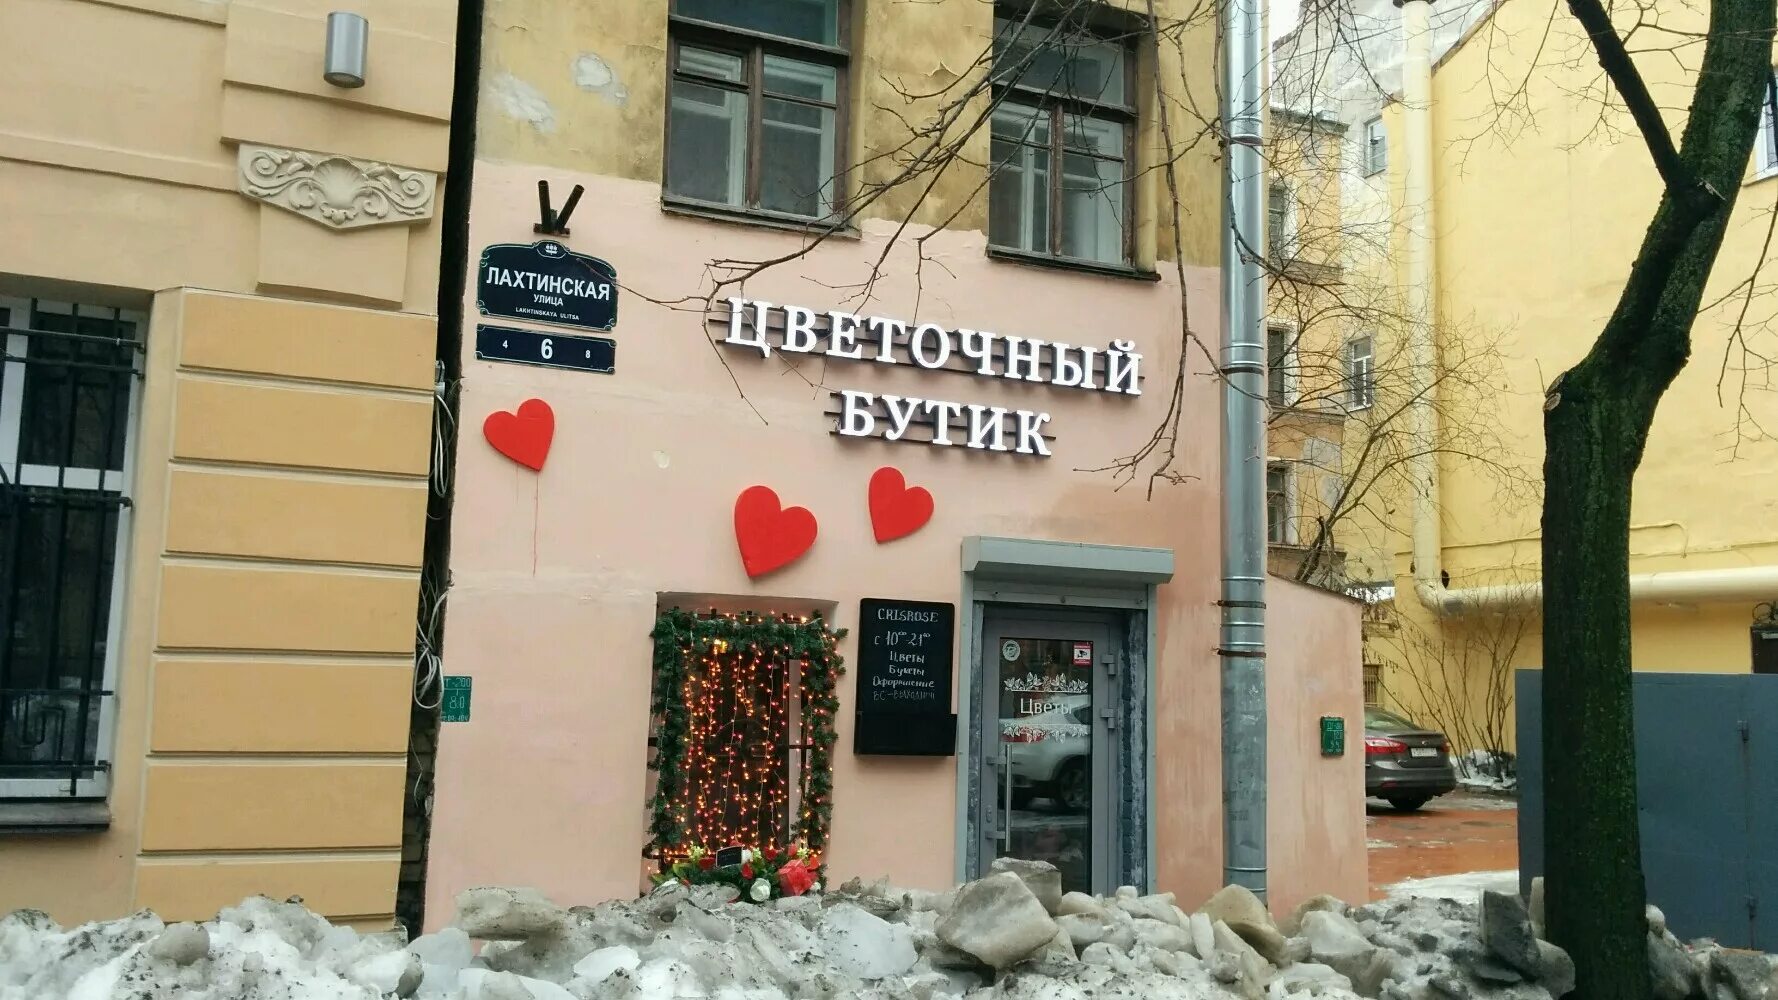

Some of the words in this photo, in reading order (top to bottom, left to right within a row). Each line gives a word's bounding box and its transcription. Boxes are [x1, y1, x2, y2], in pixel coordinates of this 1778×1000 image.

[486, 266, 610, 301] ЛАХТИНСКАЯ
[533, 294, 564, 307] УЛИЦА
[515, 306, 558, 318] LAKHTINSKAYA
[559, 312, 580, 321] ULITSA
[502, 340, 509, 349] 4
[541, 338, 553, 360] 6
[585, 349, 591, 359] 8
[724, 296, 1143, 396] ЦВЕТОЧНЫЙ
[839, 390, 1052, 456] БУТИК
[889, 650, 925, 663] Цветы
[888, 664, 925, 677] Букеты
[1020, 698, 1073, 716] Цветы
